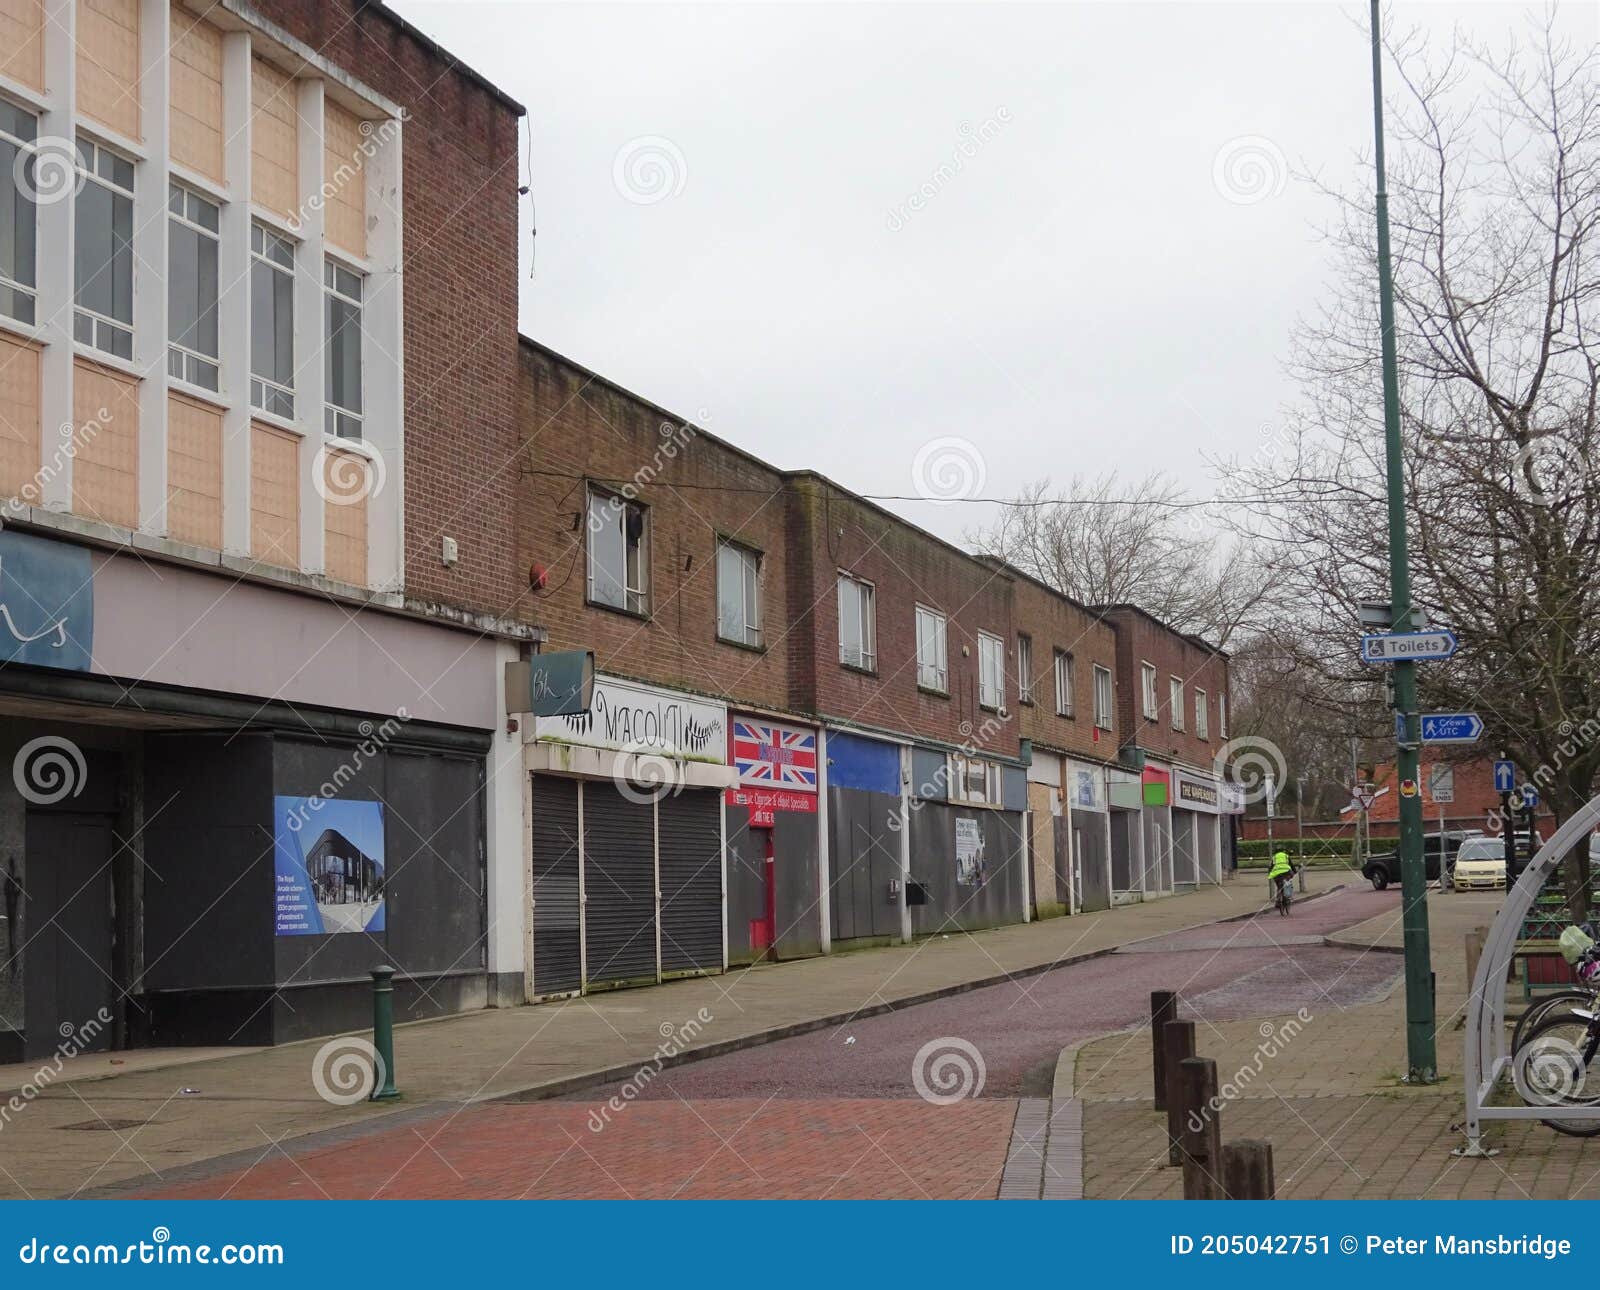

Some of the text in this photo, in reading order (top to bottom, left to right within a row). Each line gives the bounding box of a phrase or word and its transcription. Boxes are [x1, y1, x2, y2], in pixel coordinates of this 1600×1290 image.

[1390, 640, 1439, 653] Toilets
[1440, 719, 1466, 727] Crewe
[1440, 727, 1458, 736] UTC
